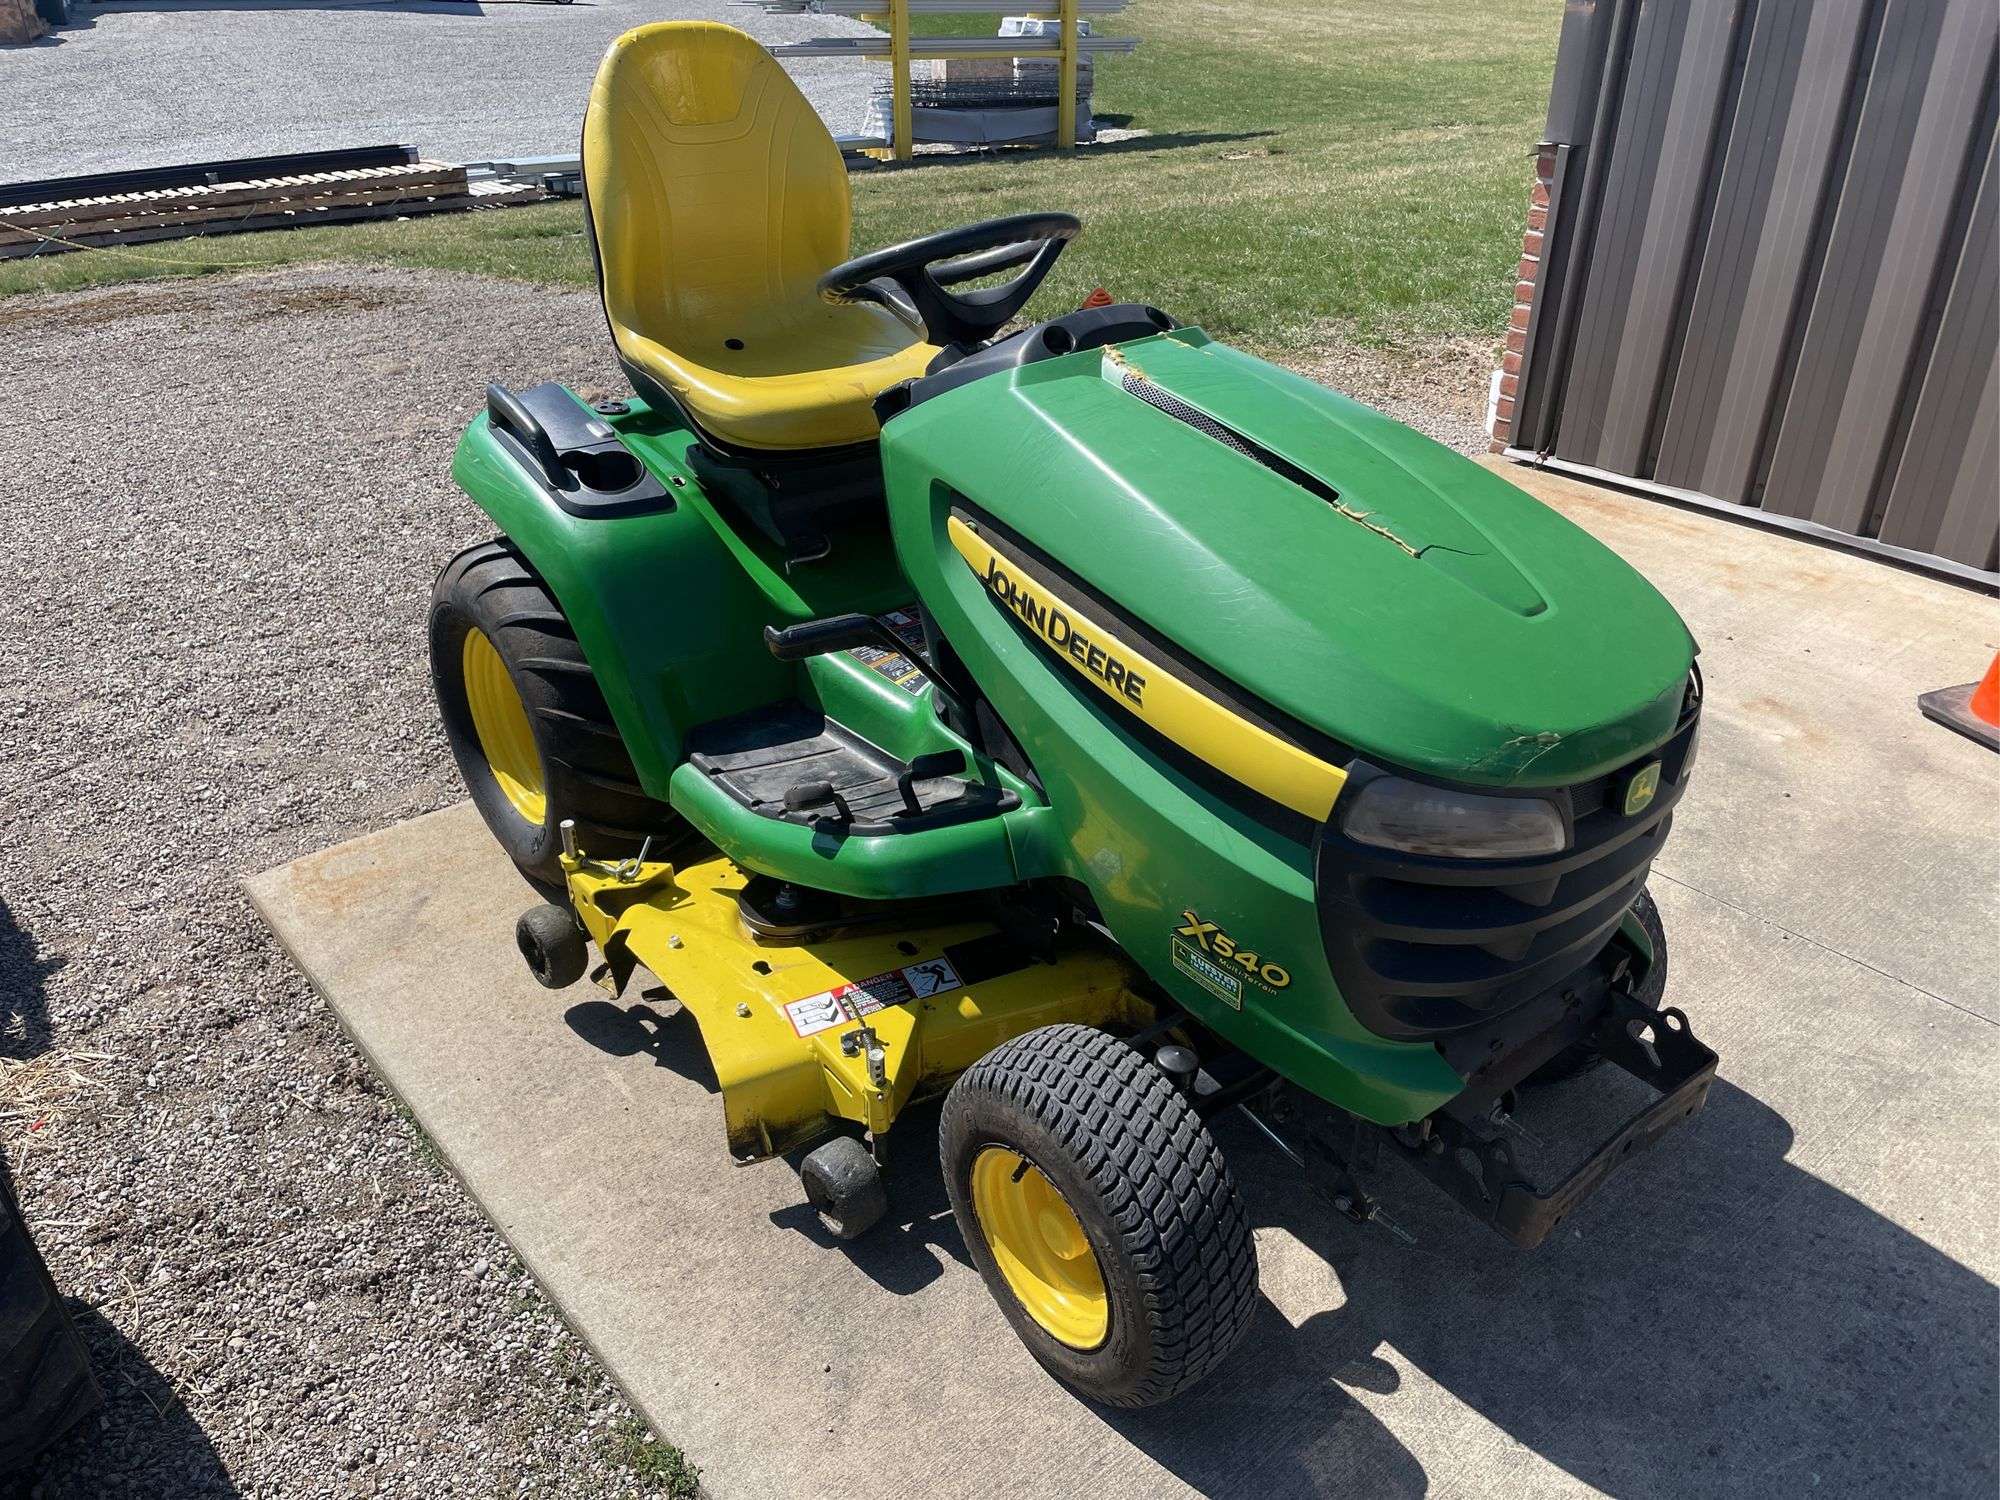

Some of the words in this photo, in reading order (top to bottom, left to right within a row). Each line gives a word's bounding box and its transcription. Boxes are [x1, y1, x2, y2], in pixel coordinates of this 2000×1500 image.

[981, 556, 1046, 635] JOHN
[1048, 607, 1147, 709] DEERE
[1175, 910, 1291, 988] X540
[1218, 958, 1278, 996] Multi-Terrain
